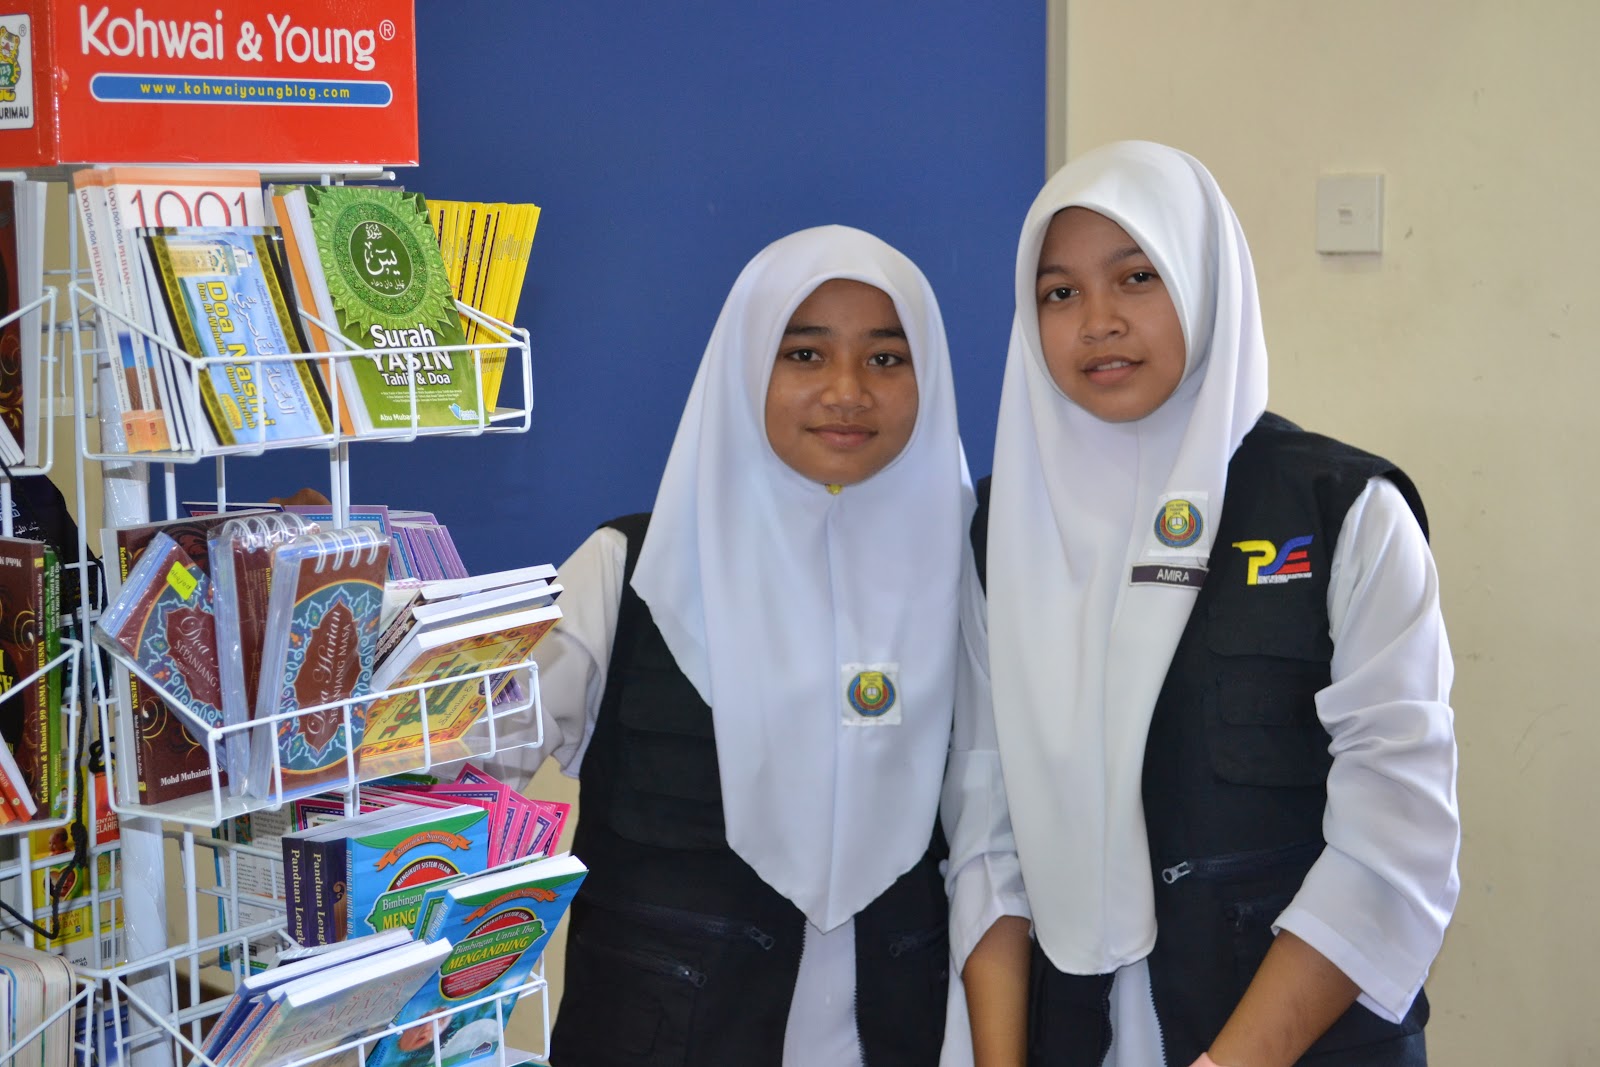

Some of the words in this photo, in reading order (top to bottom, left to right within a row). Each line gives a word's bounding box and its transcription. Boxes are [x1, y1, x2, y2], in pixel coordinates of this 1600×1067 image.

[80, 5, 224, 61] Kohwai
[236, 22, 263, 63] &
[267, 13, 376, 71] Young
[140, 81, 351, 99] www.kohwaiyoungblog.com
[80, 189, 91, 212] 1001
[107, 187, 117, 211] 1001
[130, 189, 249, 227] 1001
[195, 281, 209, 302] Doa
[206, 281, 235, 333] Doa
[370, 323, 436, 348] Surah
[371, 349, 454, 372] YASIN
[382, 373, 412, 386] Tahli
[416, 373, 427, 385] &
[427, 372, 451, 385] Doa
[119, 546, 127, 585] Kelebiha
[1156, 568, 1190, 582] AMIRA
[176, 616, 211, 654] Doa
[312, 611, 341, 684] Harian
[338, 623, 351, 656] MASA
[174, 639, 218, 687] SEPANJANG
[38, 685, 47, 707] ASMA
[130, 681, 139, 709] HUSNA
[39, 707, 46, 720] 99
[39, 721, 48, 753] Khasiat
[39, 763, 49, 804] Kelebihan
[160, 775, 180, 786] Mohd
[291, 849, 301, 903] Panduan
[313, 853, 324, 907] Panduan
[396, 865, 421, 887] MENGIKUTI
[421, 861, 438, 869] SISTEM
[437, 863, 451, 875] ISLAM
[382, 894, 423, 911] Bimbingan
[295, 907, 306, 945] Lengk
[454, 937, 494, 955] Bimbingan
[495, 928, 520, 942] Untuk
[521, 925, 535, 935] Ibu
[447, 936, 530, 971] MENGANDUNG
